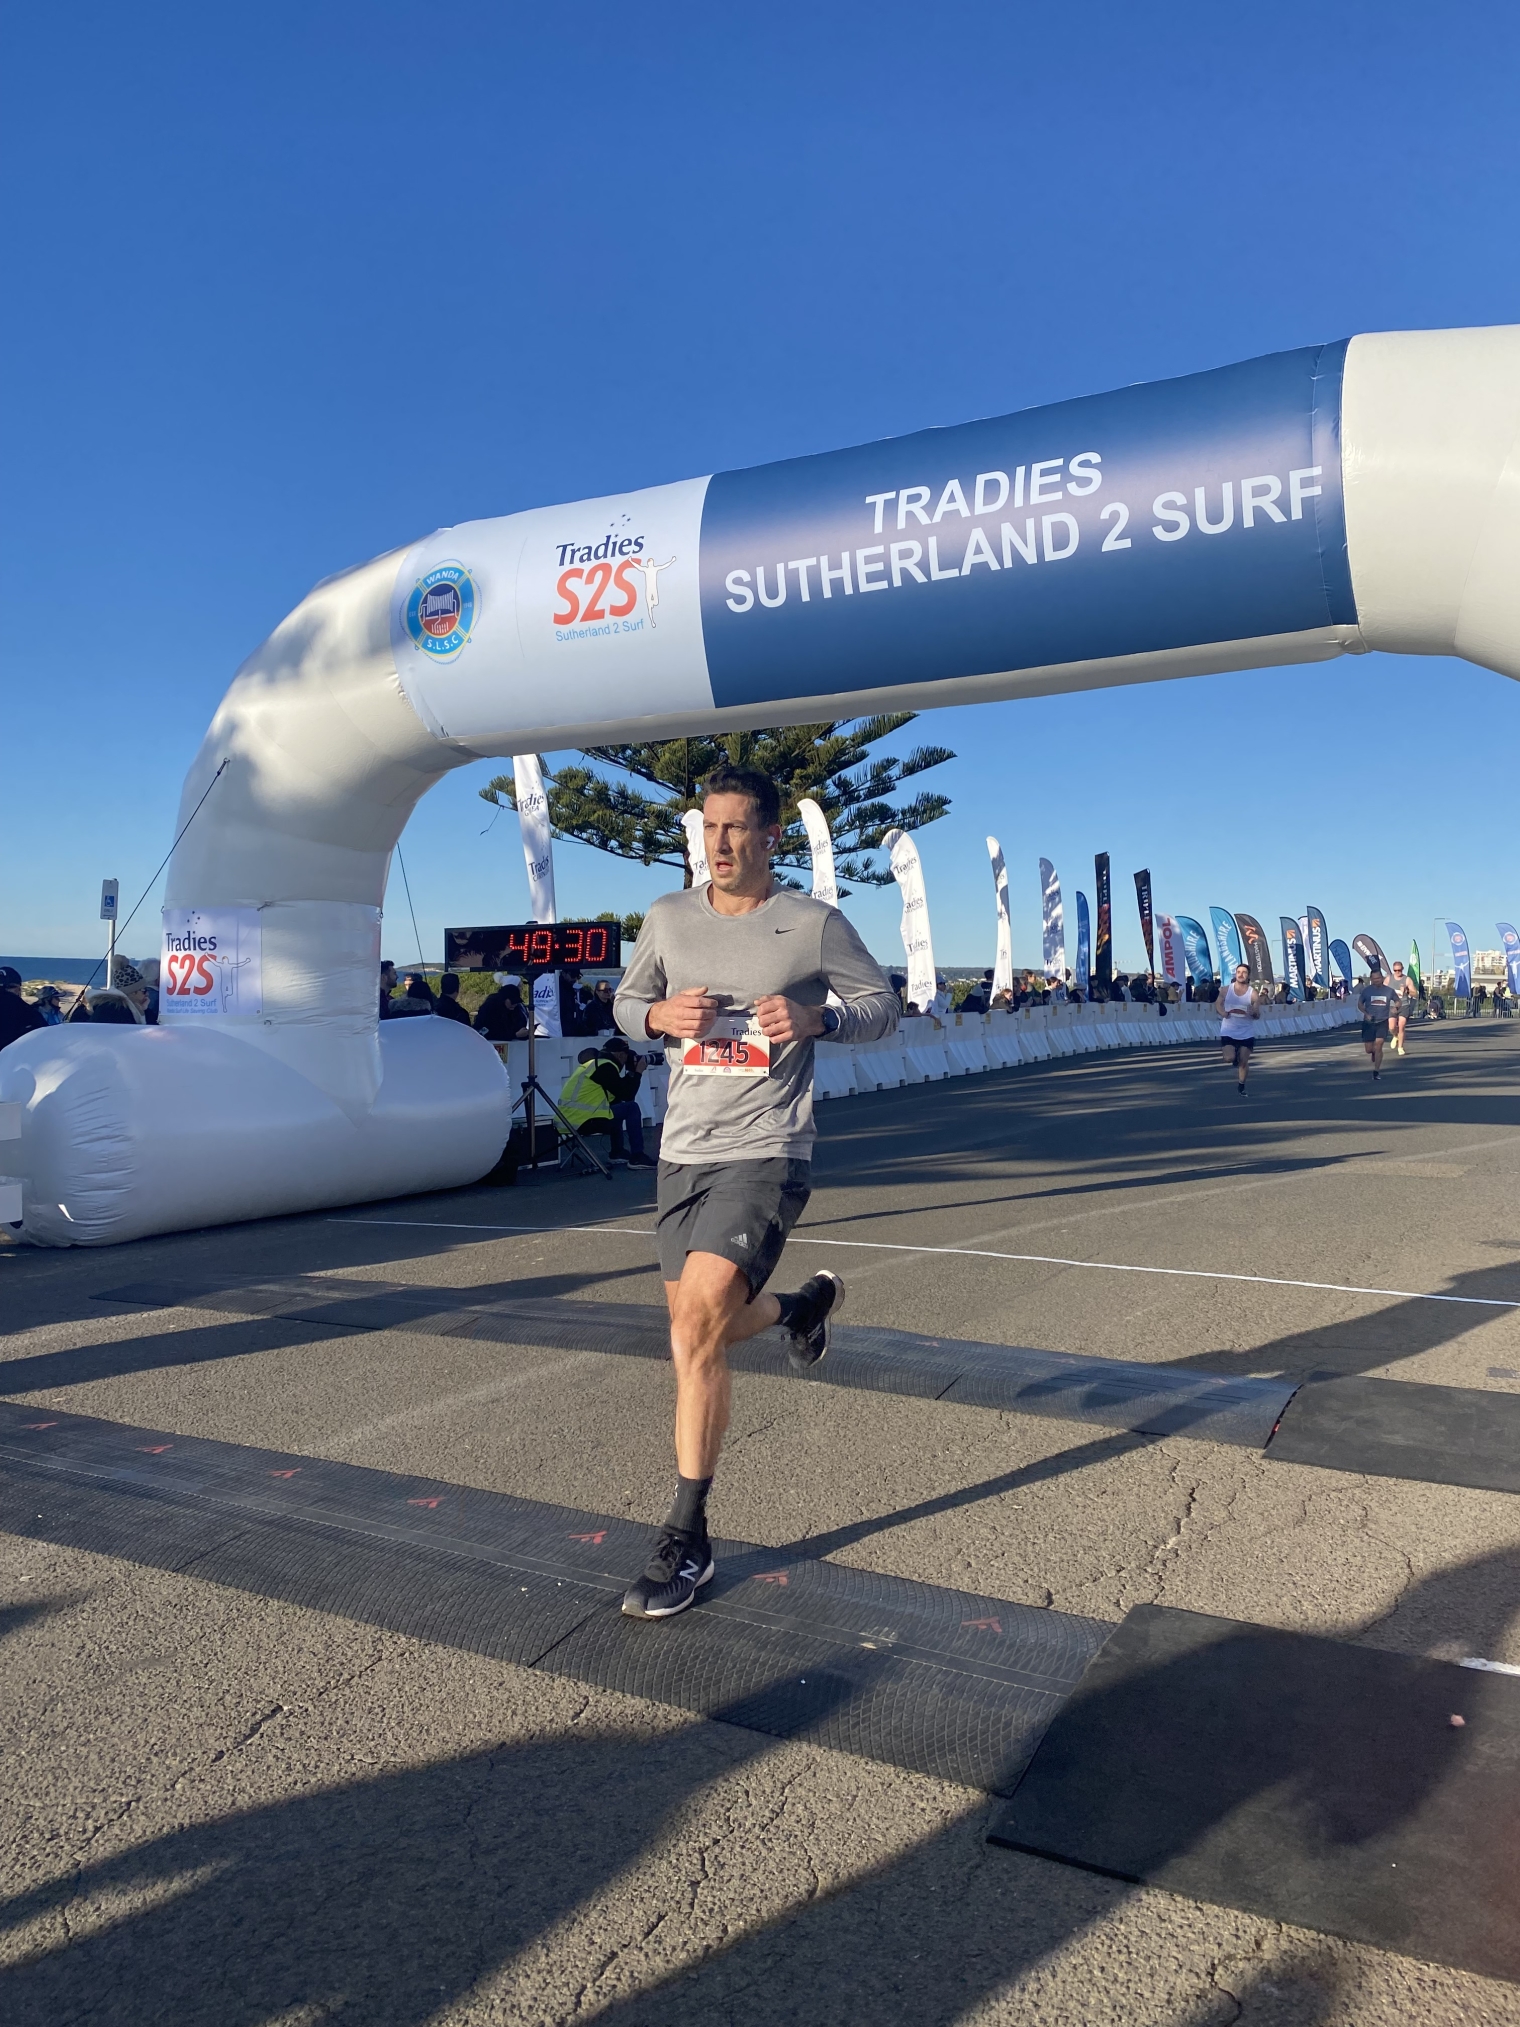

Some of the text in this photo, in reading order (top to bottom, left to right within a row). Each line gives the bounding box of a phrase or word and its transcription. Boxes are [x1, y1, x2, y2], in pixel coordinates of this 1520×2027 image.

[865, 452, 1102, 534] TRADIES
[555, 534, 645, 567] Tradies
[725, 466, 1324, 614] SUTHERLAND 2 SURF
[426, 570, 459, 585] WANDA
[553, 558, 642, 626] S2S
[556, 618, 645, 642] Sutherland 2 Surf
[166, 930, 218, 952] Tradies
[1162, 917, 1176, 979] AMPOL
[166, 953, 218, 996] S2S
[166, 998, 218, 1007] Sutherland 2 Surf
[731, 1027, 762, 1036] Tradies
[700, 1041, 749, 1064] 1245
